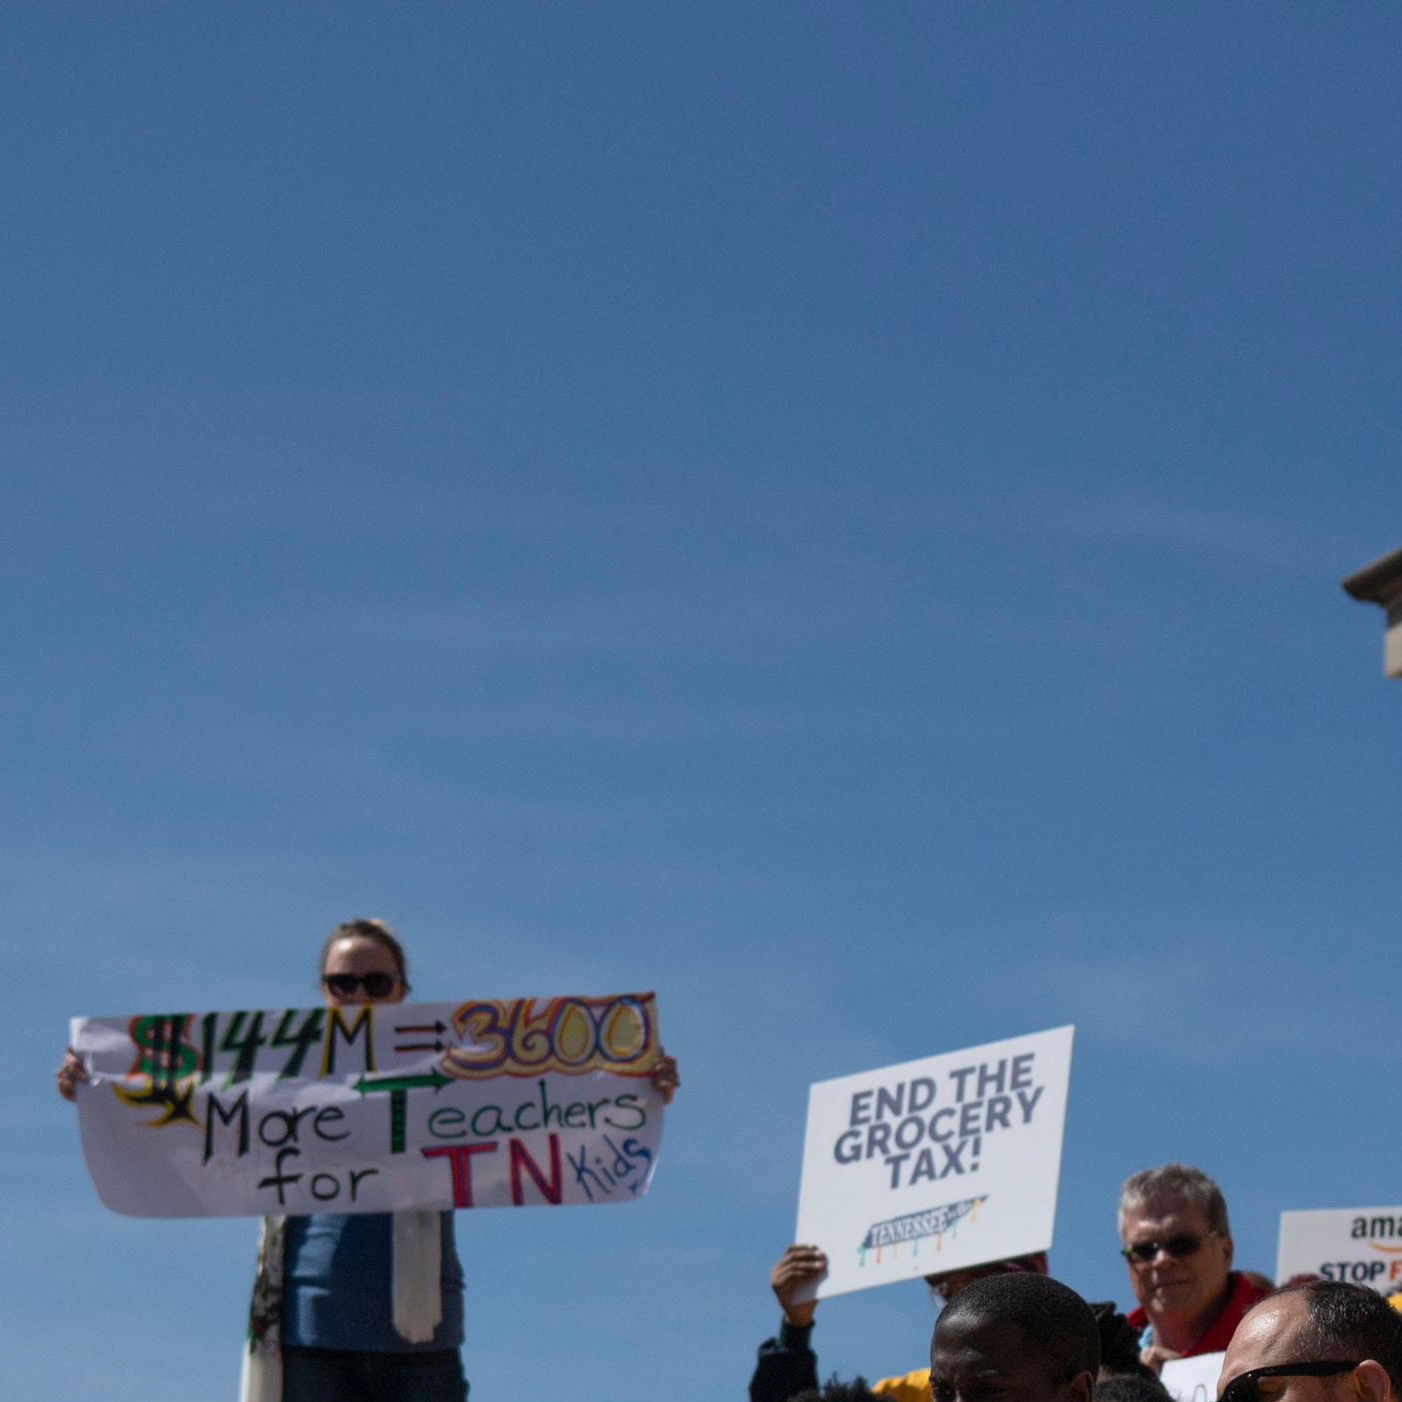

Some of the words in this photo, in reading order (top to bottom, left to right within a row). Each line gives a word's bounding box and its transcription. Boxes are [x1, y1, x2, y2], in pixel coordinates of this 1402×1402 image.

[441, 994, 654, 1081] 3600
[351, 1068, 648, 1154] Teachers
[833, 1086, 1045, 1166] GROCERY
[849, 1076, 937, 1127] END
[949, 1052, 1036, 1104] THE
[257, 1146, 380, 1206] for
[420, 1133, 564, 1209] TN
[566, 1133, 654, 1202] Kids
[884, 1136, 983, 1190] TAX!
[1320, 1261, 1386, 1281] STOP
